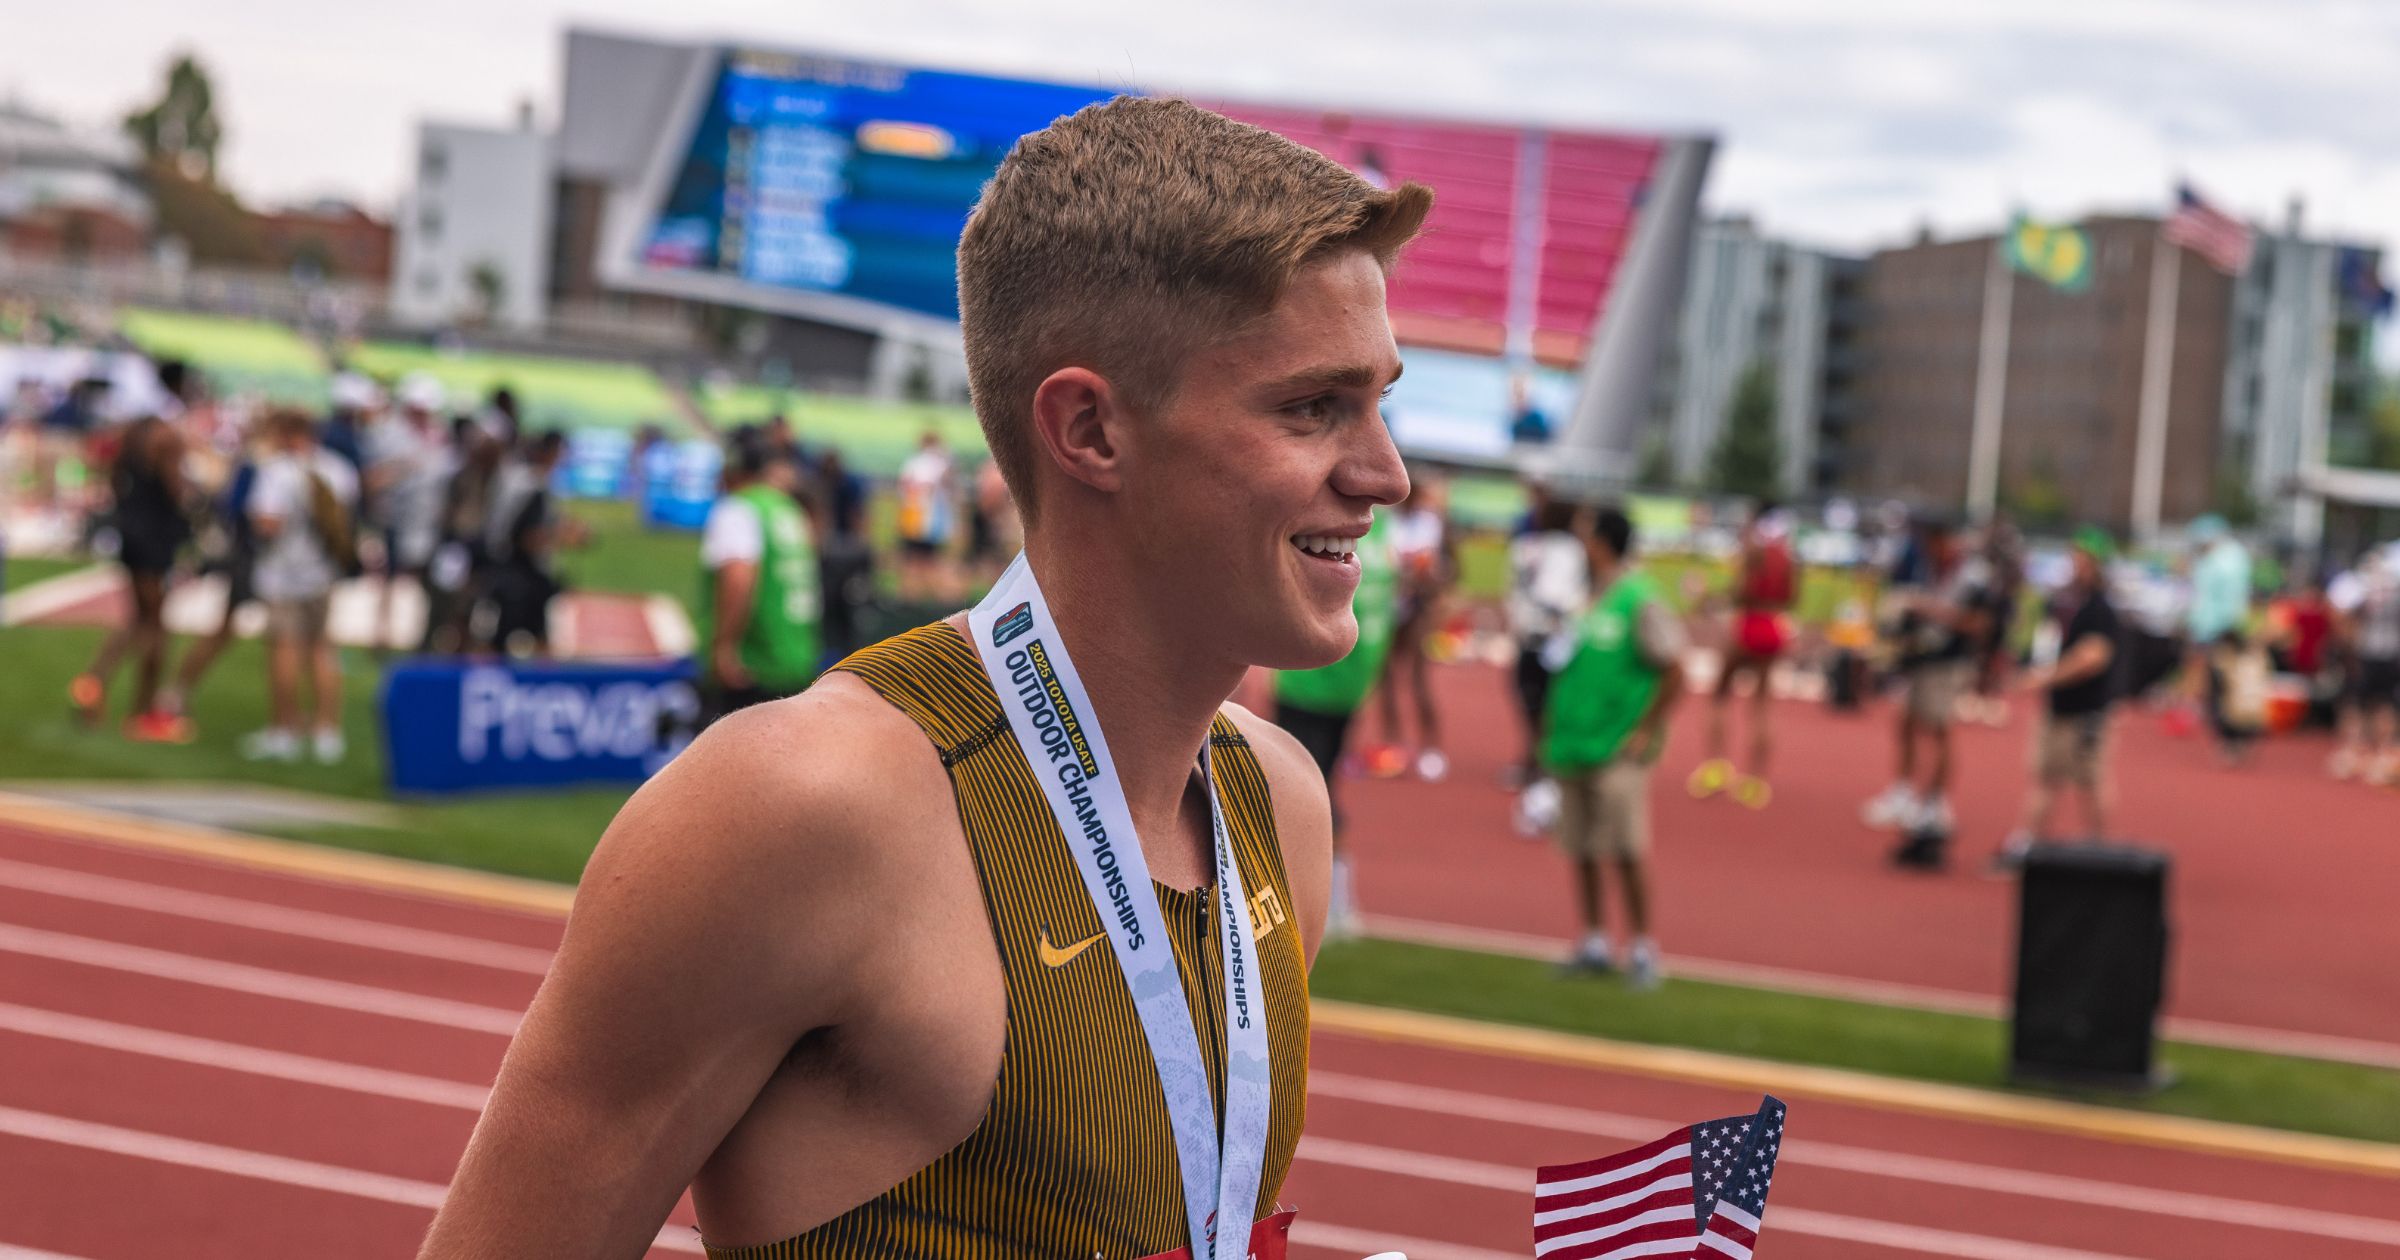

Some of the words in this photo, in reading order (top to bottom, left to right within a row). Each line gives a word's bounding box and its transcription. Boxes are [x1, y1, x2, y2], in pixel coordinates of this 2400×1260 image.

[1005, 650, 1071, 764] OUTDOOR
[1058, 763, 1145, 951] CHAMPIONSHIPS
[1029, 643, 1052, 679] 2025
[1045, 678, 1077, 732] TOYOTA
[1071, 733, 1097, 776] USATF
